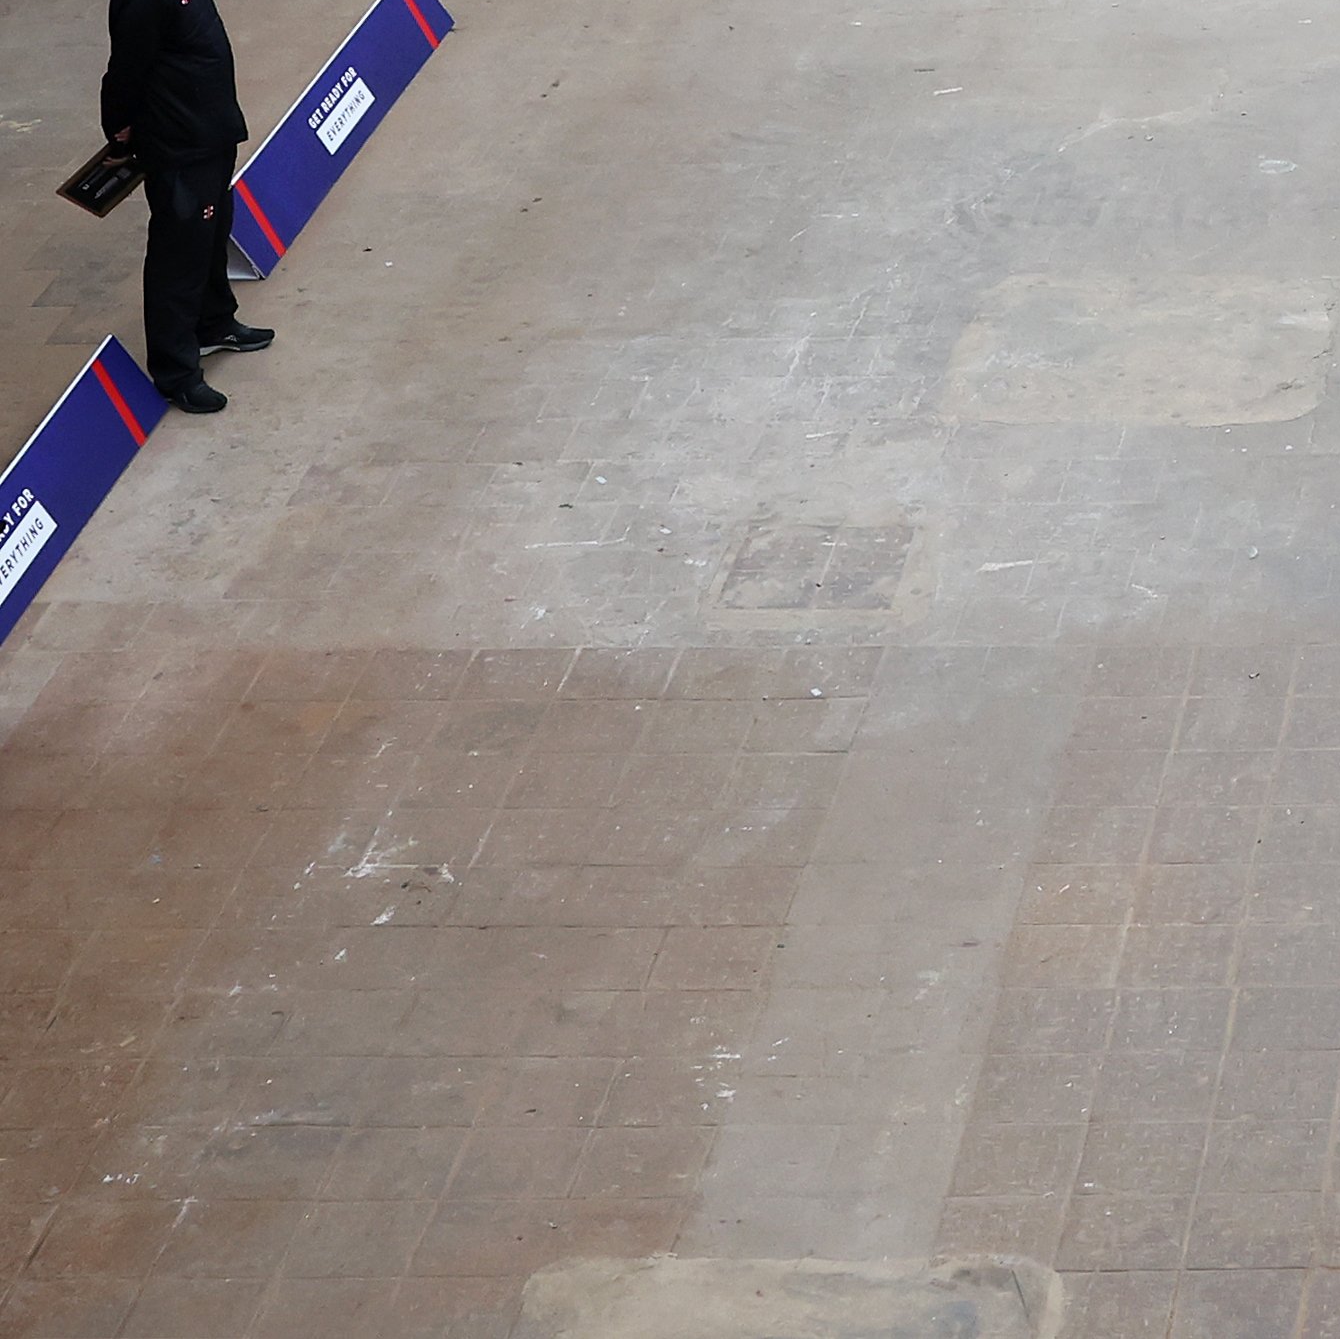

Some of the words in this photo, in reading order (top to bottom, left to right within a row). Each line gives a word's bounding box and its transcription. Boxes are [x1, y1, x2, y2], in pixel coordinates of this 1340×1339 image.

[308, 108, 324, 129] GET
[320, 82, 344, 113] READY
[340, 66, 358, 87] FOR
[326, 90, 366, 141] EVERYTHING
[11, 488, 35, 517] FOR
